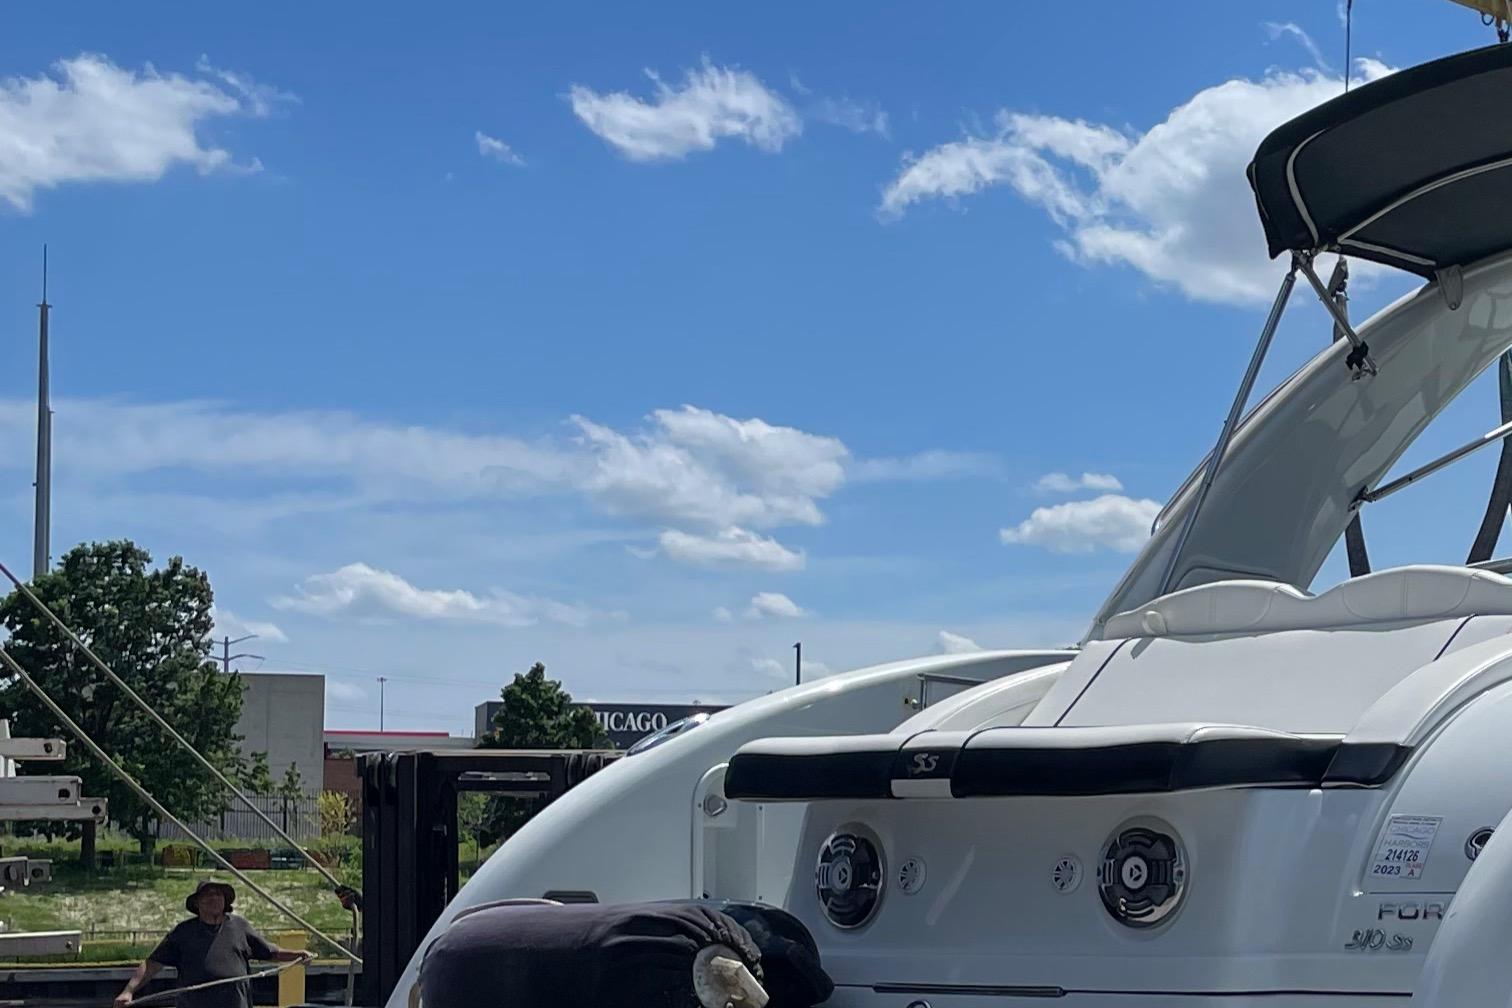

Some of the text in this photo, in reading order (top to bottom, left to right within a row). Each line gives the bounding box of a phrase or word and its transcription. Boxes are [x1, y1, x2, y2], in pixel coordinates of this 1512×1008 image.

[1385, 849, 1420, 863] 214126
[1373, 864, 1401, 876] 2023
[1377, 902, 1447, 921] FOR
